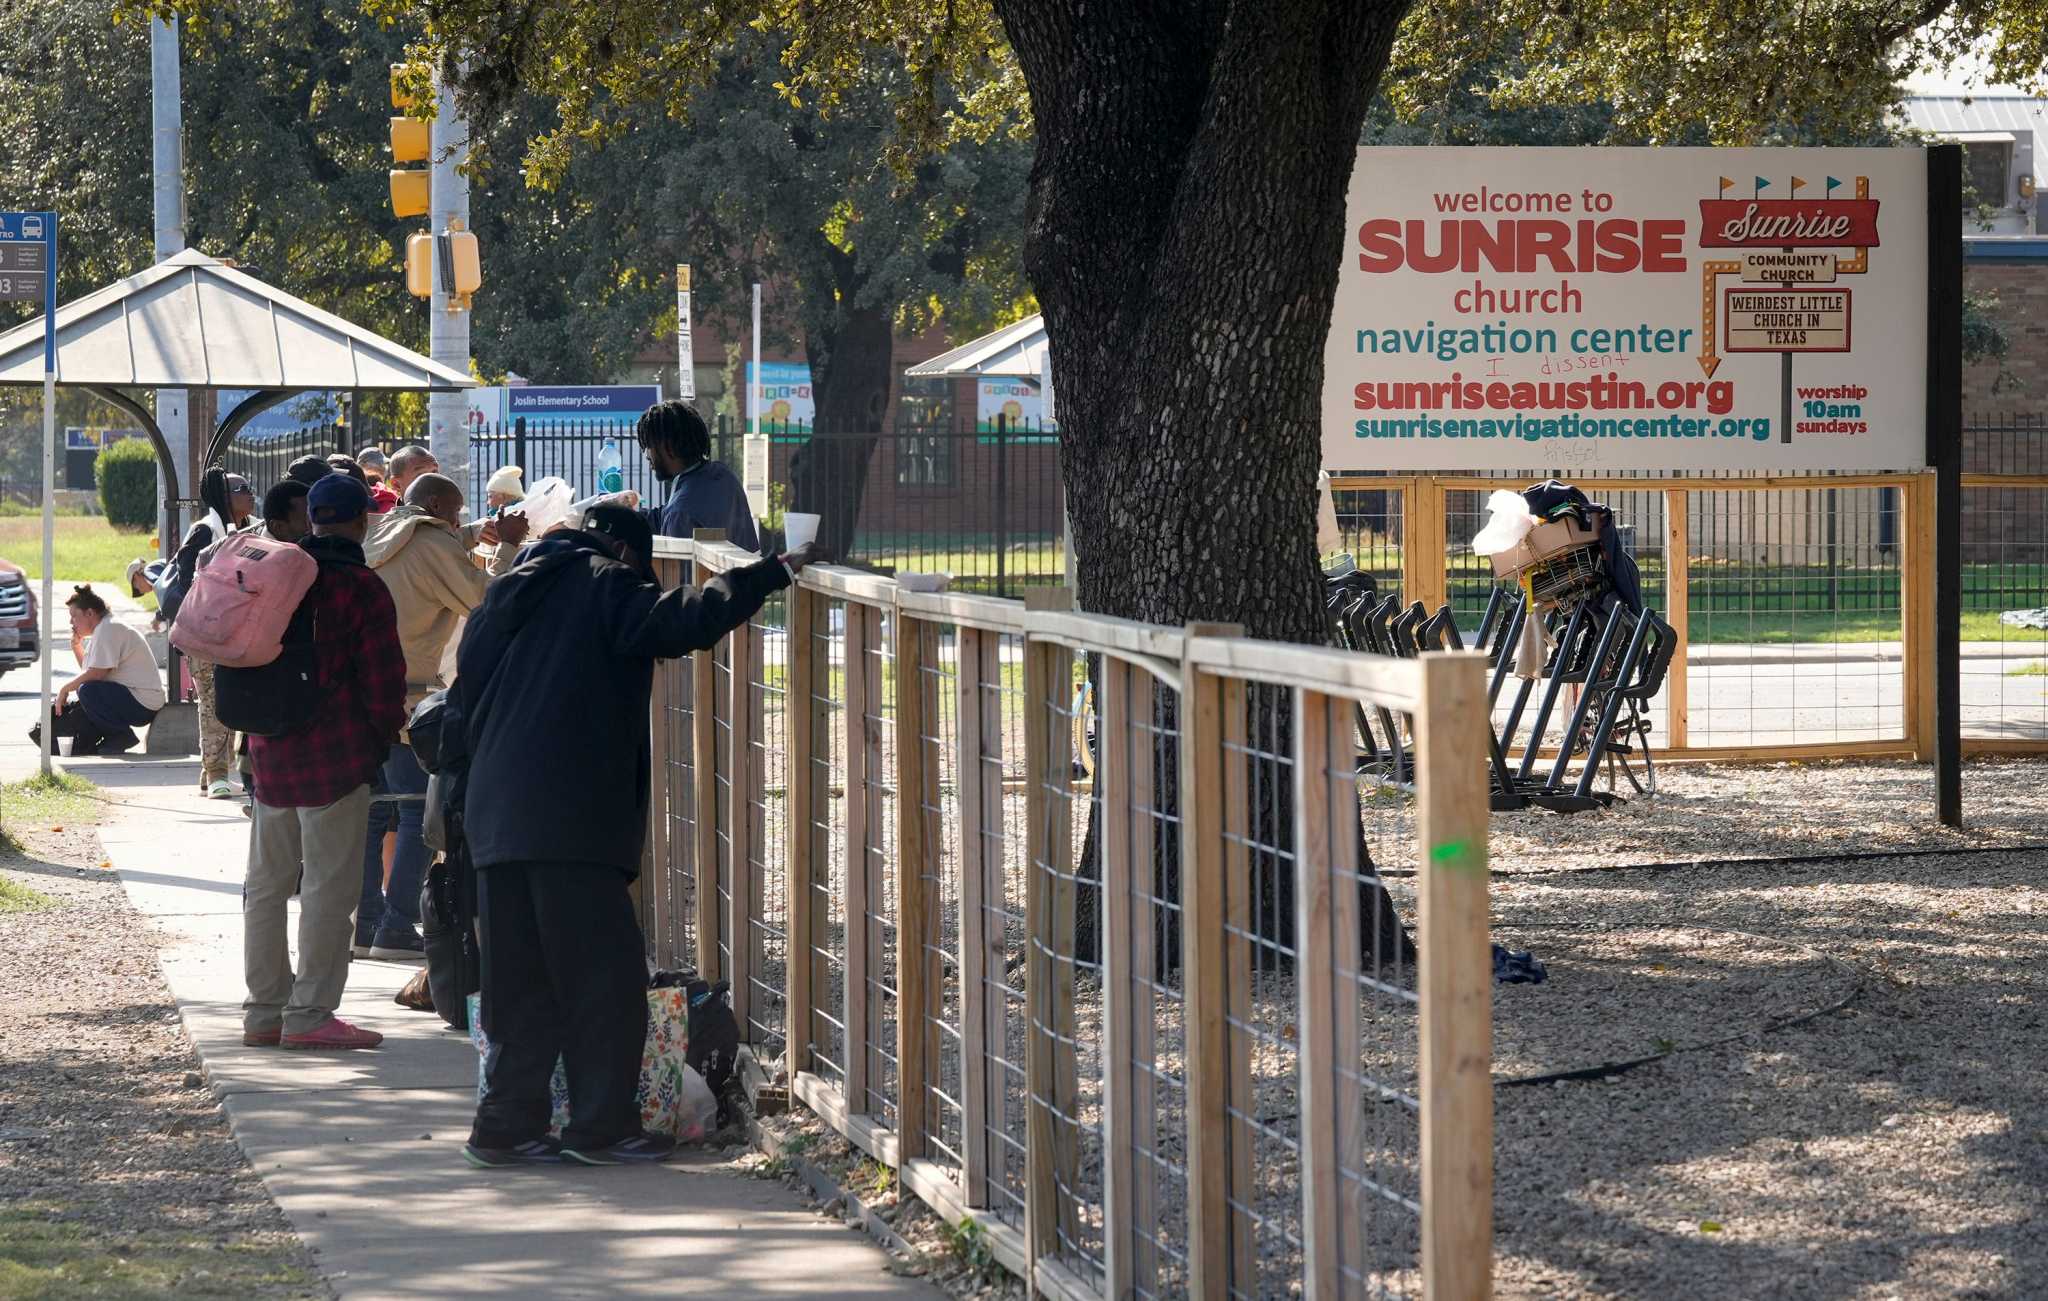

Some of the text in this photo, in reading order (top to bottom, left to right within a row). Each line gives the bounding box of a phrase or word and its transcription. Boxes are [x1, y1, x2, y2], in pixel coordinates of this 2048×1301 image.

[1433, 186, 1614, 213] welcome to
[1718, 203, 1850, 242] Sunrise
[1358, 218, 1688, 274] SUNRISE
[1747, 255, 1828, 266] COMMUNITY
[1760, 269, 1815, 281] CHURCH
[1453, 279, 1583, 314] church
[1732, 296, 1843, 310] WEIRDEST LITTLE
[1753, 313, 1821, 328] CHURCH IN
[1356, 320, 1693, 362] navigation center
[1766, 330, 1807, 344] TEXAS
[1485, 351, 1630, 377] I dissent
[513, 394, 610, 408] Joslin Elementary School
[1353, 372, 1734, 415] sunriseaustin.org
[1796, 384, 1868, 401] worship
[1803, 400, 1861, 418] 10am
[1354, 413, 1771, 441] sunrisenavigationcenter.org
[1796, 419, 1868, 435] sundays
